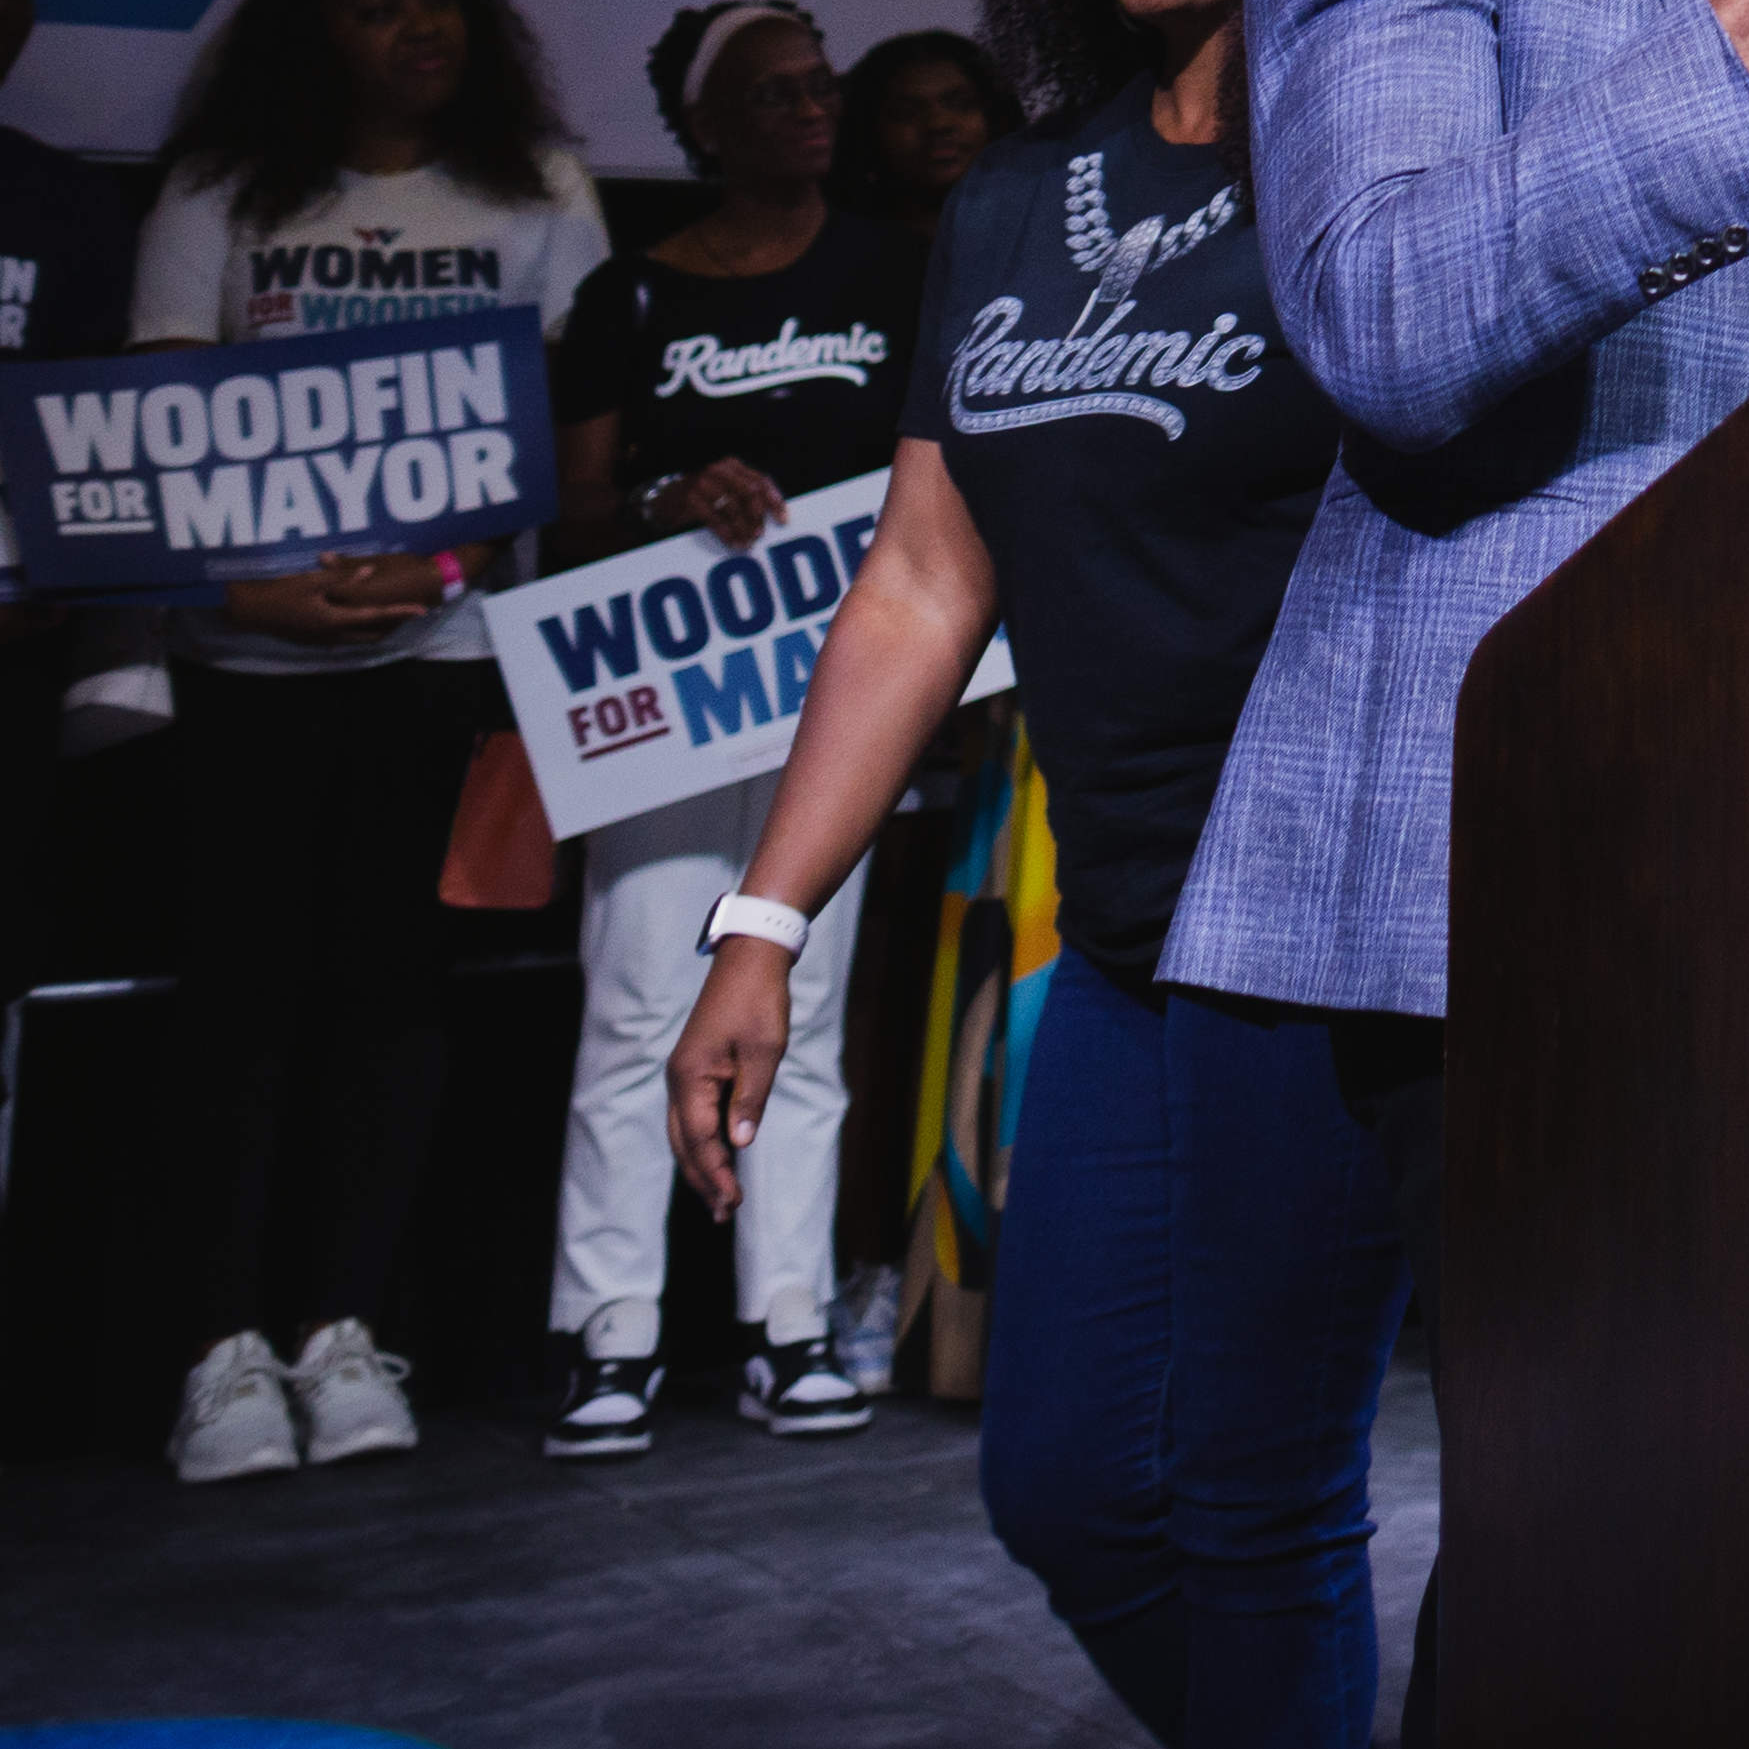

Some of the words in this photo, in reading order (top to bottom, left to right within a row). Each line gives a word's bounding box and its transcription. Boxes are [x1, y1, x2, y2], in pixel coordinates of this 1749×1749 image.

[251, 245, 499, 294] WOMEN
[302, 292, 499, 331] WOOD
[654, 316, 888, 398] Randemic
[945, 295, 1267, 442] Randemic
[35, 340, 509, 475] WOODFIN
[51, 481, 153, 524] FOR
[157, 429, 520, 551] MAYOR
[567, 684, 666, 747] FOR
